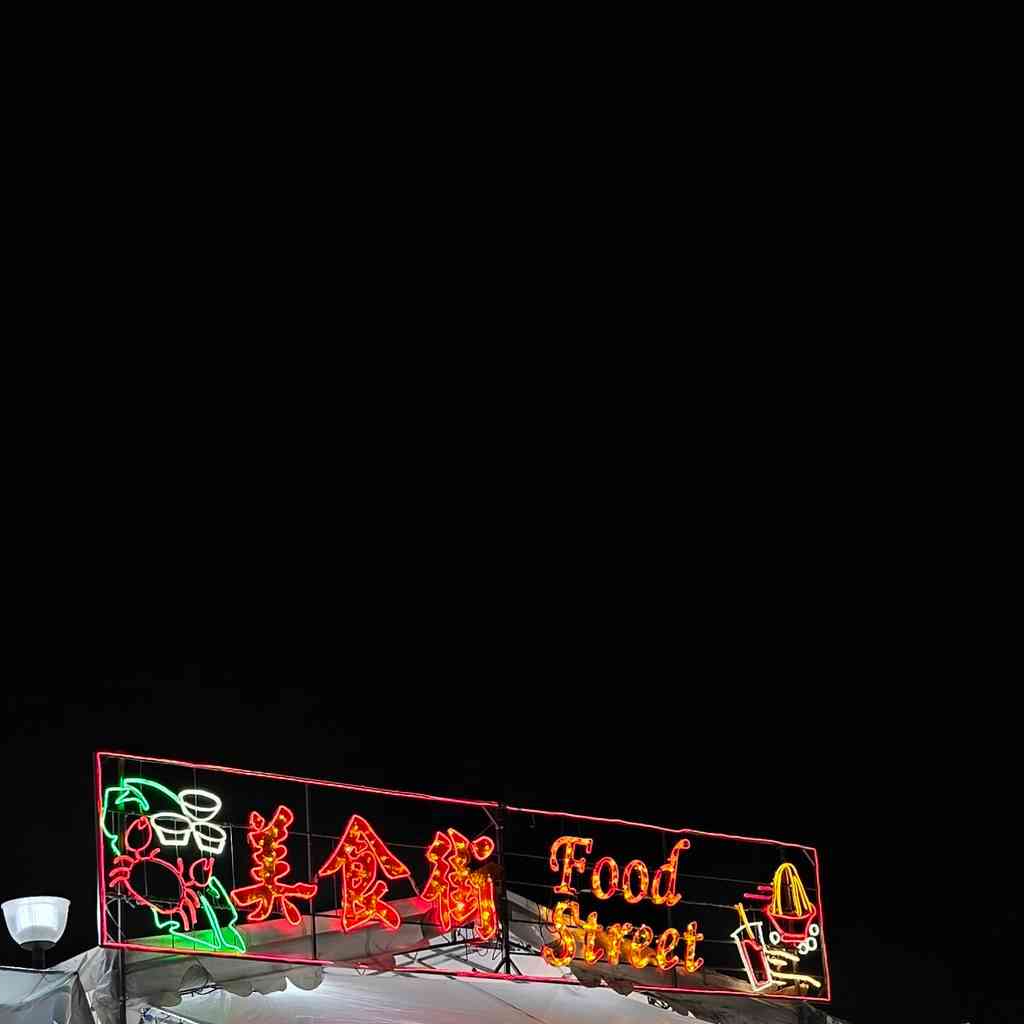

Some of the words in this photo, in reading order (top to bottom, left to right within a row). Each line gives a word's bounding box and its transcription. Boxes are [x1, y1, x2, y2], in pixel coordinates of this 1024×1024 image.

[229, 804, 497, 940] 美食街
[549, 835, 691, 906] Food
[541, 901, 705, 973] Street
